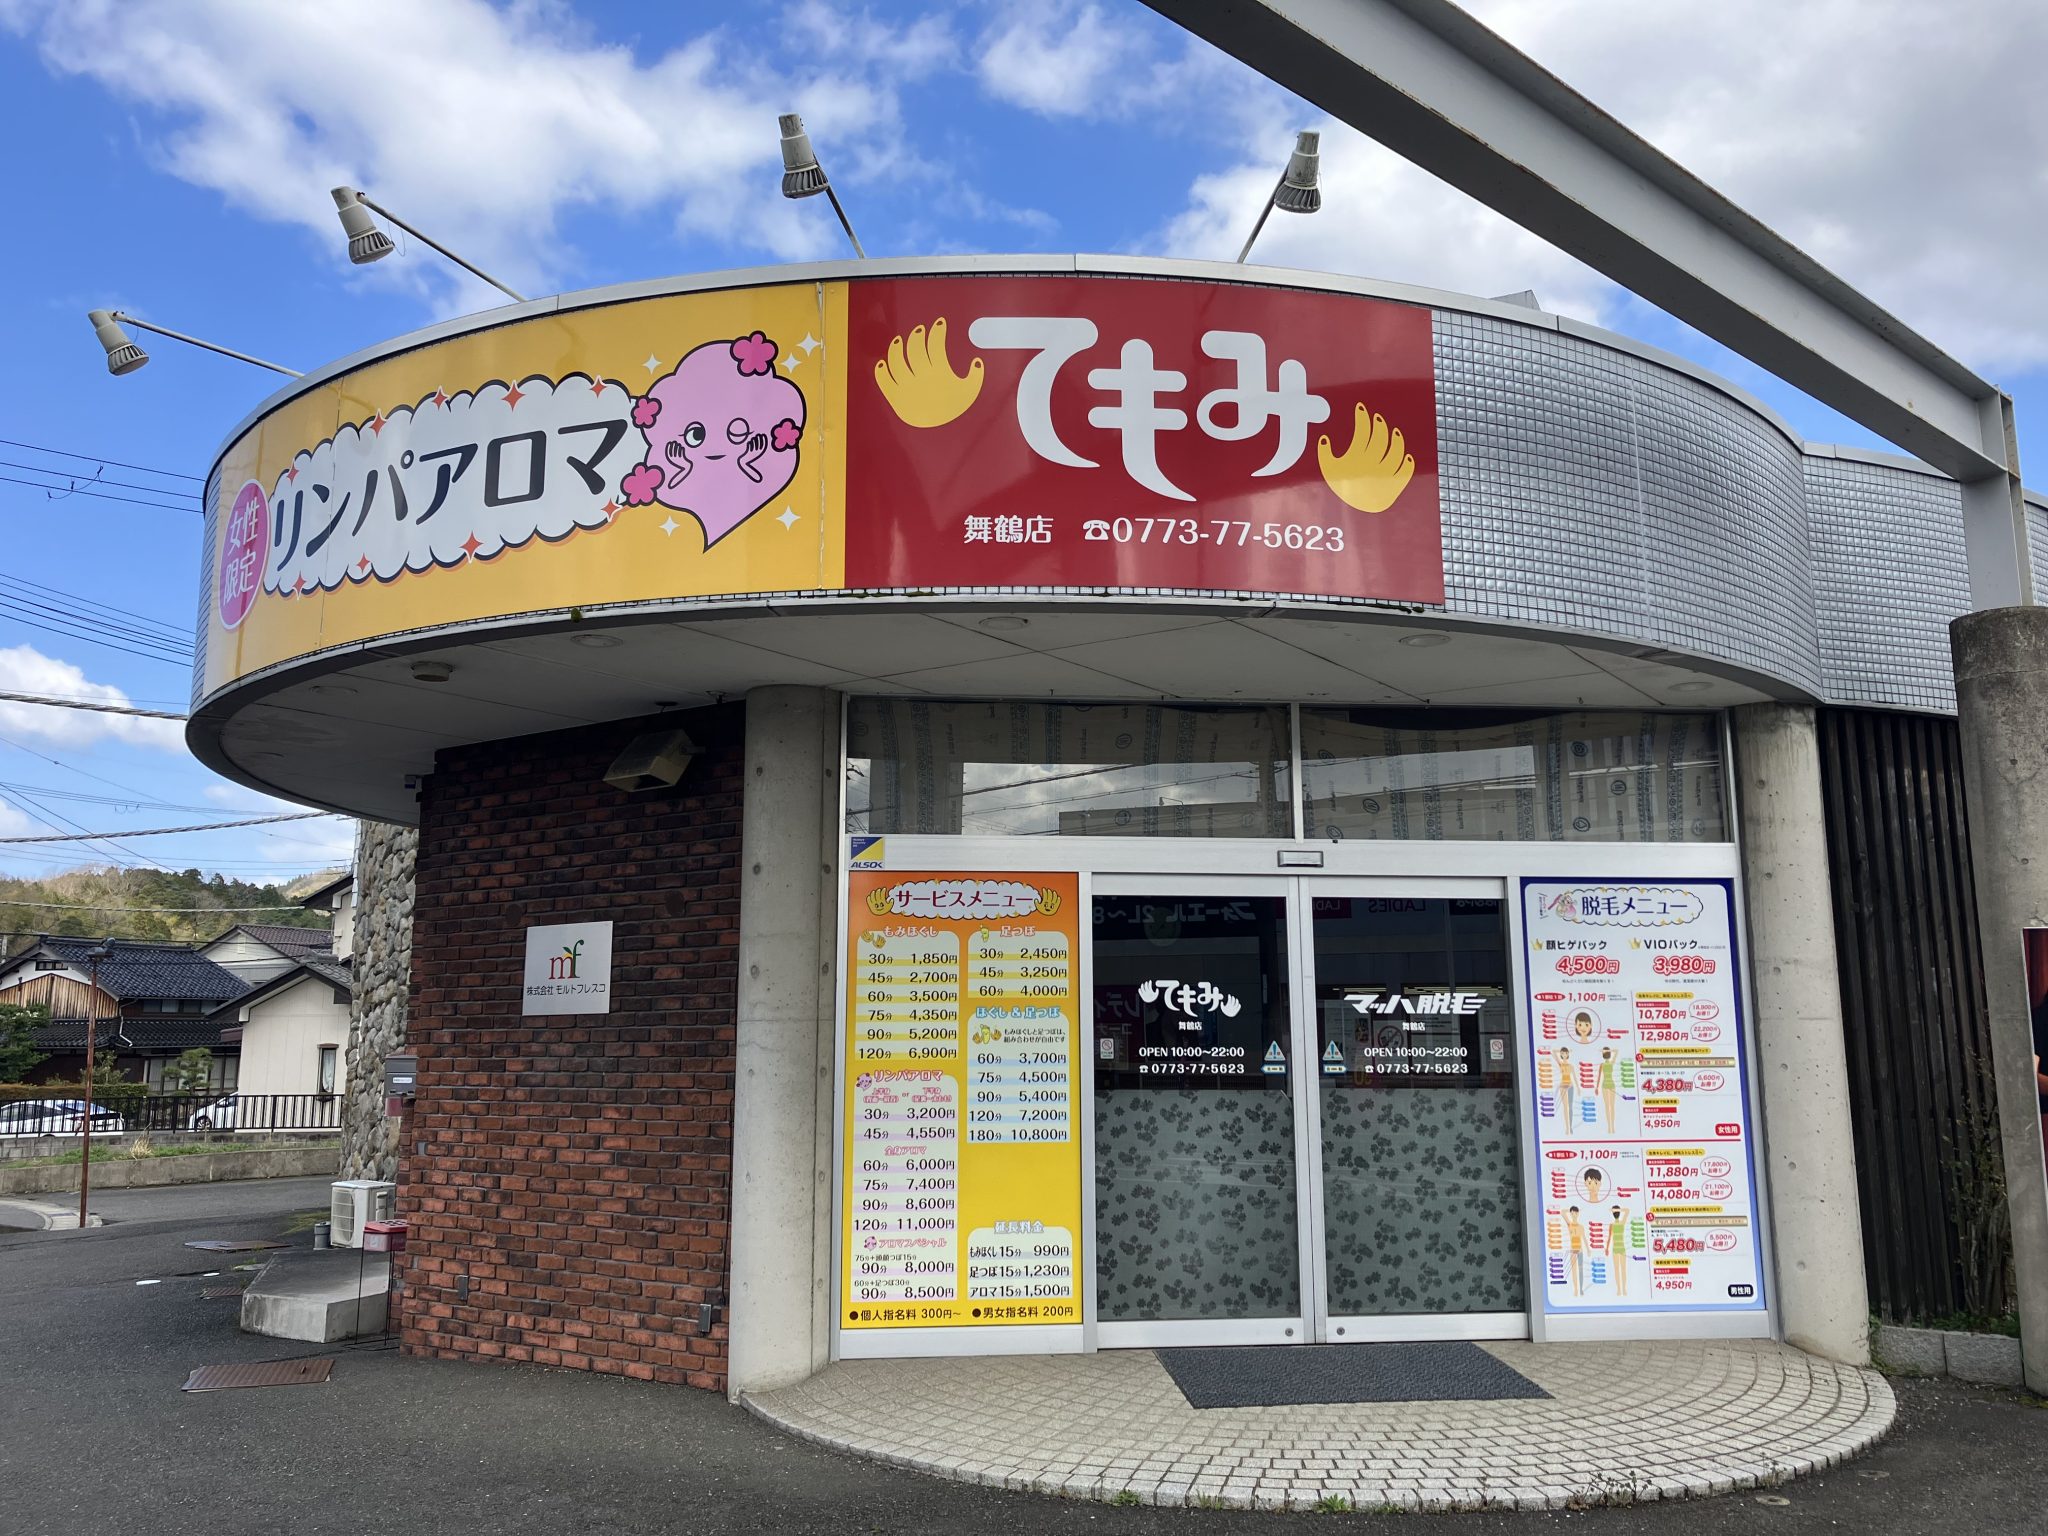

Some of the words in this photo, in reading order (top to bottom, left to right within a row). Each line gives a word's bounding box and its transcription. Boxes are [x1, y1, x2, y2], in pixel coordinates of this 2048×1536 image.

[274, 419, 628, 569] リンパアロマ
[228, 504, 261, 552] 女性
[964, 516, 1052, 545] 舞鶴店
[1113, 518, 1345, 552] 0773-77-5623
[224, 551, 258, 603] 限定
[897, 891, 1033, 908] サービスメニュー
[1582, 896, 1688, 916] 脱毛メニュー
[883, 926, 938, 937] もみほぐし
[1000, 925, 1035, 936] 足つぼ
[1546, 940, 1607, 950] 顔ヒゲパック
[1644, 939, 1698, 950] VIOパック
[868, 954, 893, 964] 30分
[912, 954, 957, 965] 1,850円
[980, 949, 1003, 958] 30分
[1020, 948, 1067, 960] 2,450円
[1556, 956, 1620, 975] 4,500円
[1653, 955, 1715, 975] 3,980円
[868, 972, 892, 982] 45分
[910, 972, 957, 984] 2,700円
[980, 967, 1003, 977] 45分
[1020, 967, 1067, 978] 3,250円
[527, 986, 553, 996] 株式会社
[556, 984, 605, 994] モルトフレスコ
[980, 986, 1003, 996] 60分
[1020, 985, 1067, 997] 4,000円
[868, 991, 892, 1001] 60分
[910, 991, 957, 1003] 3,500円
[1568, 993, 1606, 1002] 1,100円
[1344, 993, 1487, 1014] マッハ脱毛
[868, 1010, 891, 1020] 75分
[909, 1010, 957, 1021] 4,350円
[976, 1008, 1007, 1018] ほぐし
[1024, 1007, 1060, 1018] 足つぼ
[1639, 1009, 1686, 1020] 10,780円
[867, 1029, 891, 1039] 90分
[909, 1028, 957, 1040] 5,200円
[1640, 1031, 1688, 1042] 12,980円
[859, 1048, 891, 1059] 120分
[909, 1048, 957, 1059] 6,900円
[1139, 1047, 1167, 1057] OPEN
[1364, 1048, 1392, 1057] OPEN
[978, 1054, 1002, 1064] 60分
[1019, 1053, 1066, 1065] 3,700円
[978, 1072, 1002, 1083] 75分
[1019, 1072, 1066, 1084] 4,500円
[1642, 1079, 1693, 1094] 4,380円
[977, 1092, 1001, 1102] 90分
[1019, 1091, 1066, 1103] 5,400円
[865, 1109, 889, 1119] 30分
[907, 1108, 955, 1120] 3,200円
[970, 1111, 1001, 1121] 120分
[1019, 1110, 1066, 1123] 7,200円
[1645, 1119, 1680, 1129] 4,950円
[864, 1128, 888, 1139] 45分
[907, 1127, 955, 1140] 4,550円
[970, 1130, 1001, 1141] 180分
[1012, 1129, 1067, 1141] 10,800円
[1580, 1150, 1617, 1160] 1,100円
[863, 1160, 888, 1171] 60分
[906, 1159, 955, 1172] 6,000円
[1649, 1167, 1698, 1177] 11,880円
[863, 1179, 887, 1190] 75分
[906, 1178, 955, 1191] 7,400円
[1650, 1189, 1699, 1200] 14,080円
[863, 1200, 887, 1210] 90分
[906, 1199, 954, 1211] 8,600円
[854, 1220, 887, 1230] 120分
[897, 1218, 954, 1232] 11,000円
[994, 1221, 1044, 1234] 延長料金
[1034, 1245, 1069, 1256] 990円
[1654, 1238, 1704, 1254] 5,480円
[861, 1263, 887, 1274] 90分
[905, 1262, 954, 1274] 8,000円
[1656, 1281, 1692, 1290] 4,950円
[861, 1288, 886, 1299] 90分
[905, 1287, 954, 1299] 8,500円
[861, 1310, 916, 1320] 個人指名料
[983, 1307, 1038, 1318] 男女指名料
[1043, 1306, 1073, 1317] 200円
